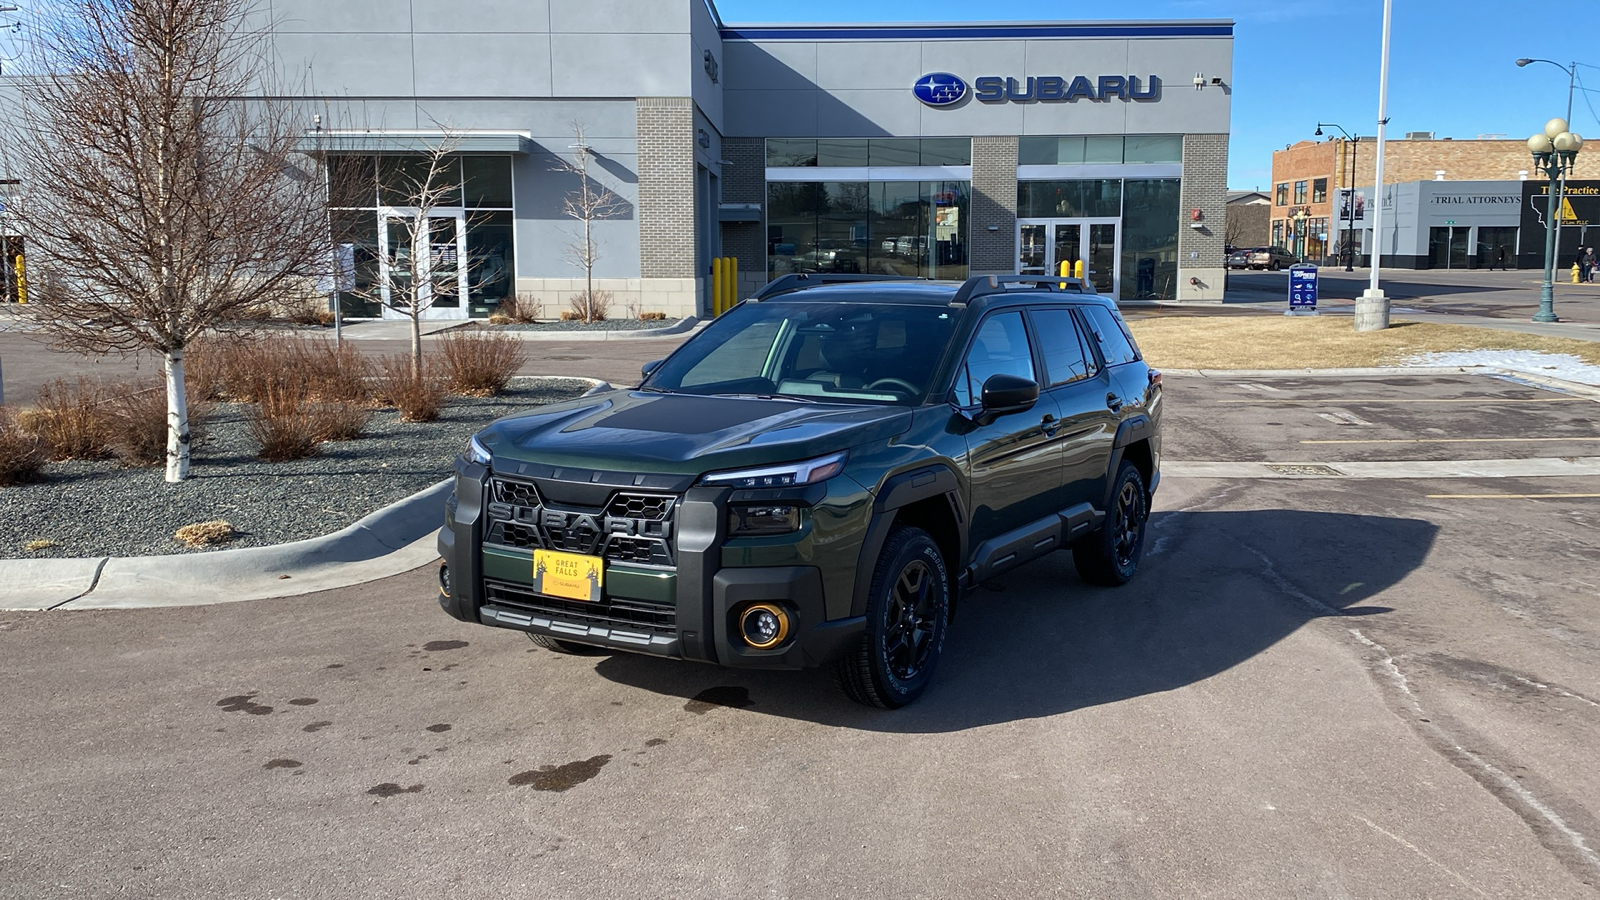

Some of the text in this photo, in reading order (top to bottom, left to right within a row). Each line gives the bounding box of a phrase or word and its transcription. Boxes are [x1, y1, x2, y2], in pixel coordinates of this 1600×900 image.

[975, 75, 1157, 101] SUBARU
[1541, 185, 1599, 194] Te Practice
[1435, 196, 1521, 204] TRIAL ATTORNEYS
[488, 502, 672, 538] SUBARU
[555, 559, 578, 568] GREAT
[555, 567, 578, 577] FALLS
